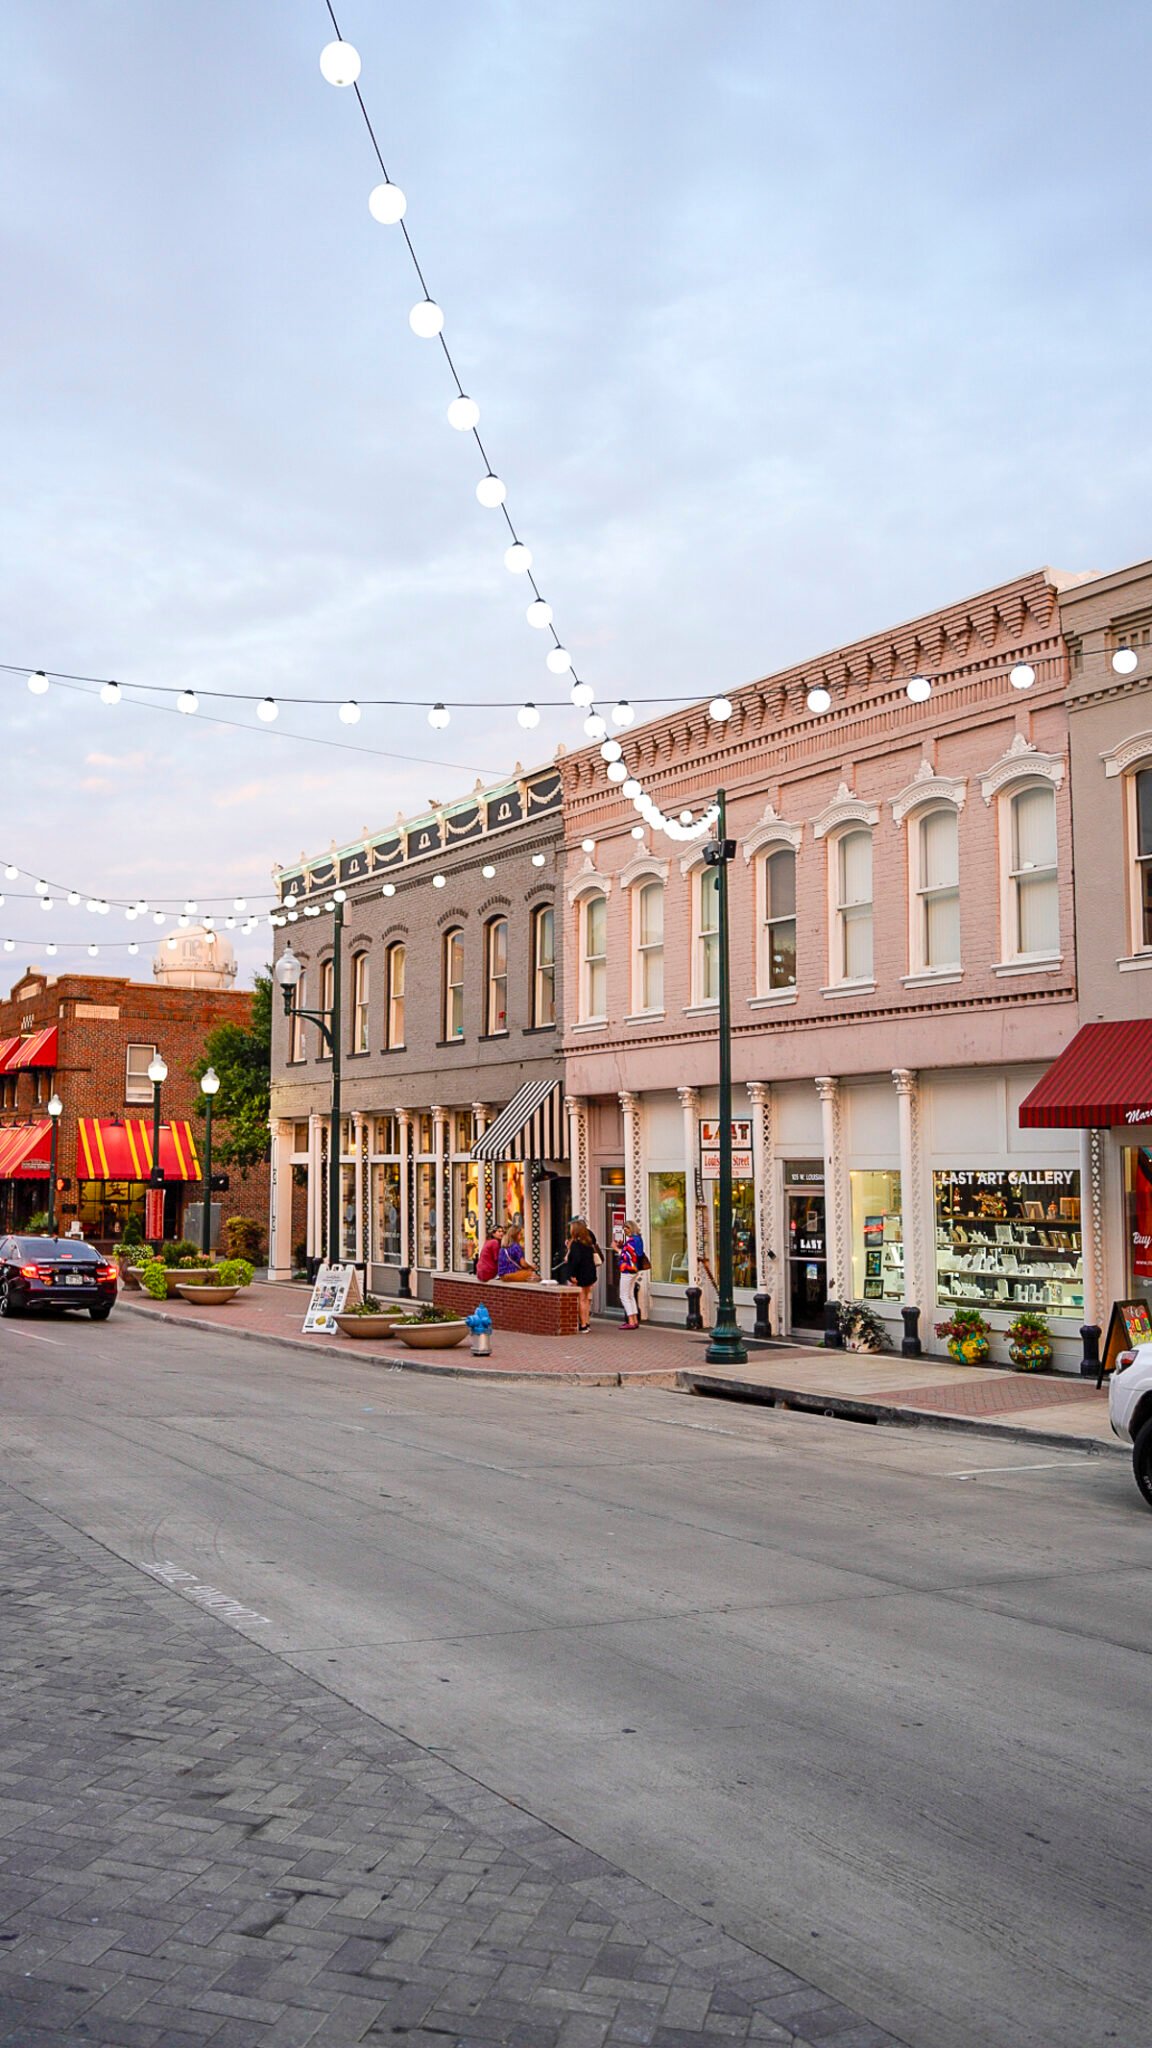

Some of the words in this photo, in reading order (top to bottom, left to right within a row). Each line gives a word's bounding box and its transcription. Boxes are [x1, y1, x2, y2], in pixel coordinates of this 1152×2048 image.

[1125, 1109, 1152, 1123] Mar
[732, 1154, 750, 1166] Street
[941, 1171, 974, 1185] LAST
[977, 1171, 1006, 1185] ART
[1008, 1171, 1074, 1185] GALLERY
[800, 1239, 823, 1250] LAST
[1132, 1231, 1151, 1249] Buy
[140, 1559, 199, 1583] ZONE
[182, 1585, 273, 1628] LOADING
